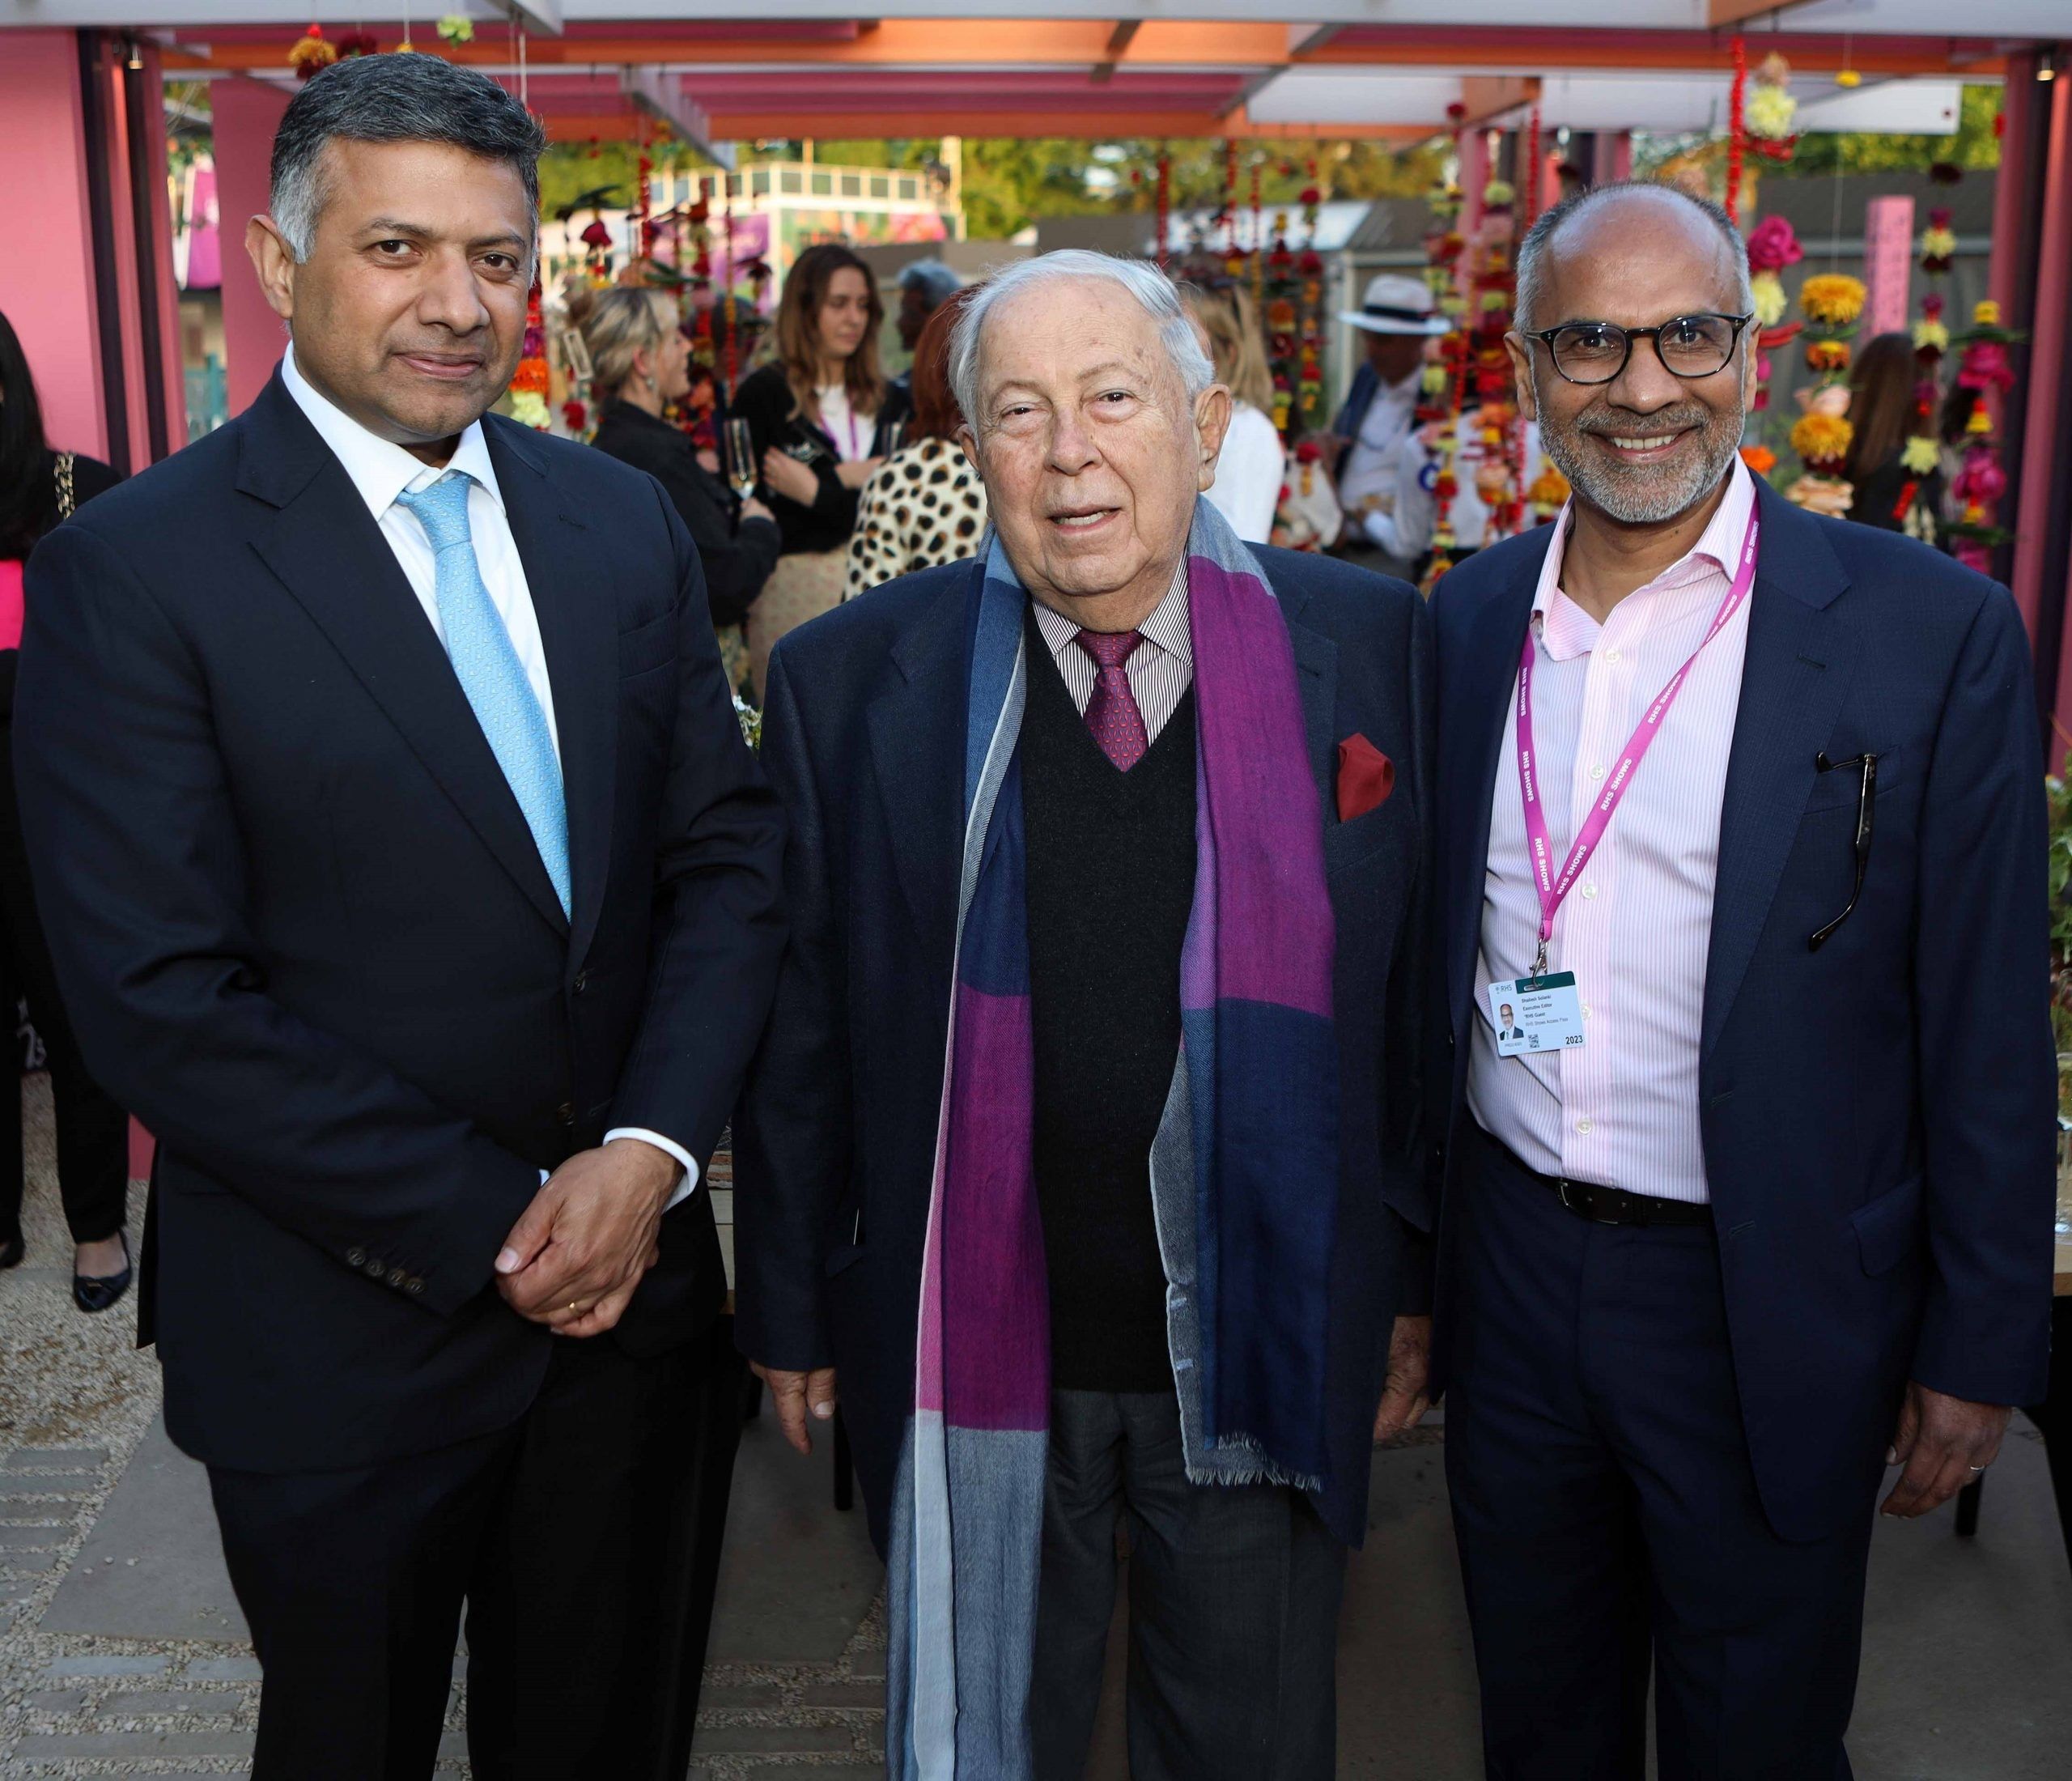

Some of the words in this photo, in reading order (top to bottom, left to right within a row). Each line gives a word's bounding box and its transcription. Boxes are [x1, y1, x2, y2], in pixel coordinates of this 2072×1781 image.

[1748, 520, 1760, 548] SHOWS
[1744, 546, 1754, 565] RHS
[1647, 704, 1662, 724] RHS
[1522, 750, 1531, 770] RHS
[1524, 770, 1535, 803] SHOWS
[1600, 790, 1615, 811] RHS
[1611, 757, 1633, 791] SHOWS
[1535, 836, 1545, 857] RHS
[1539, 858, 1551, 892] SHOWS
[1556, 876, 1569, 895] RHS
[1566, 844, 1587, 876] SHOWS
[1565, 1035, 1583, 1044] 2023
